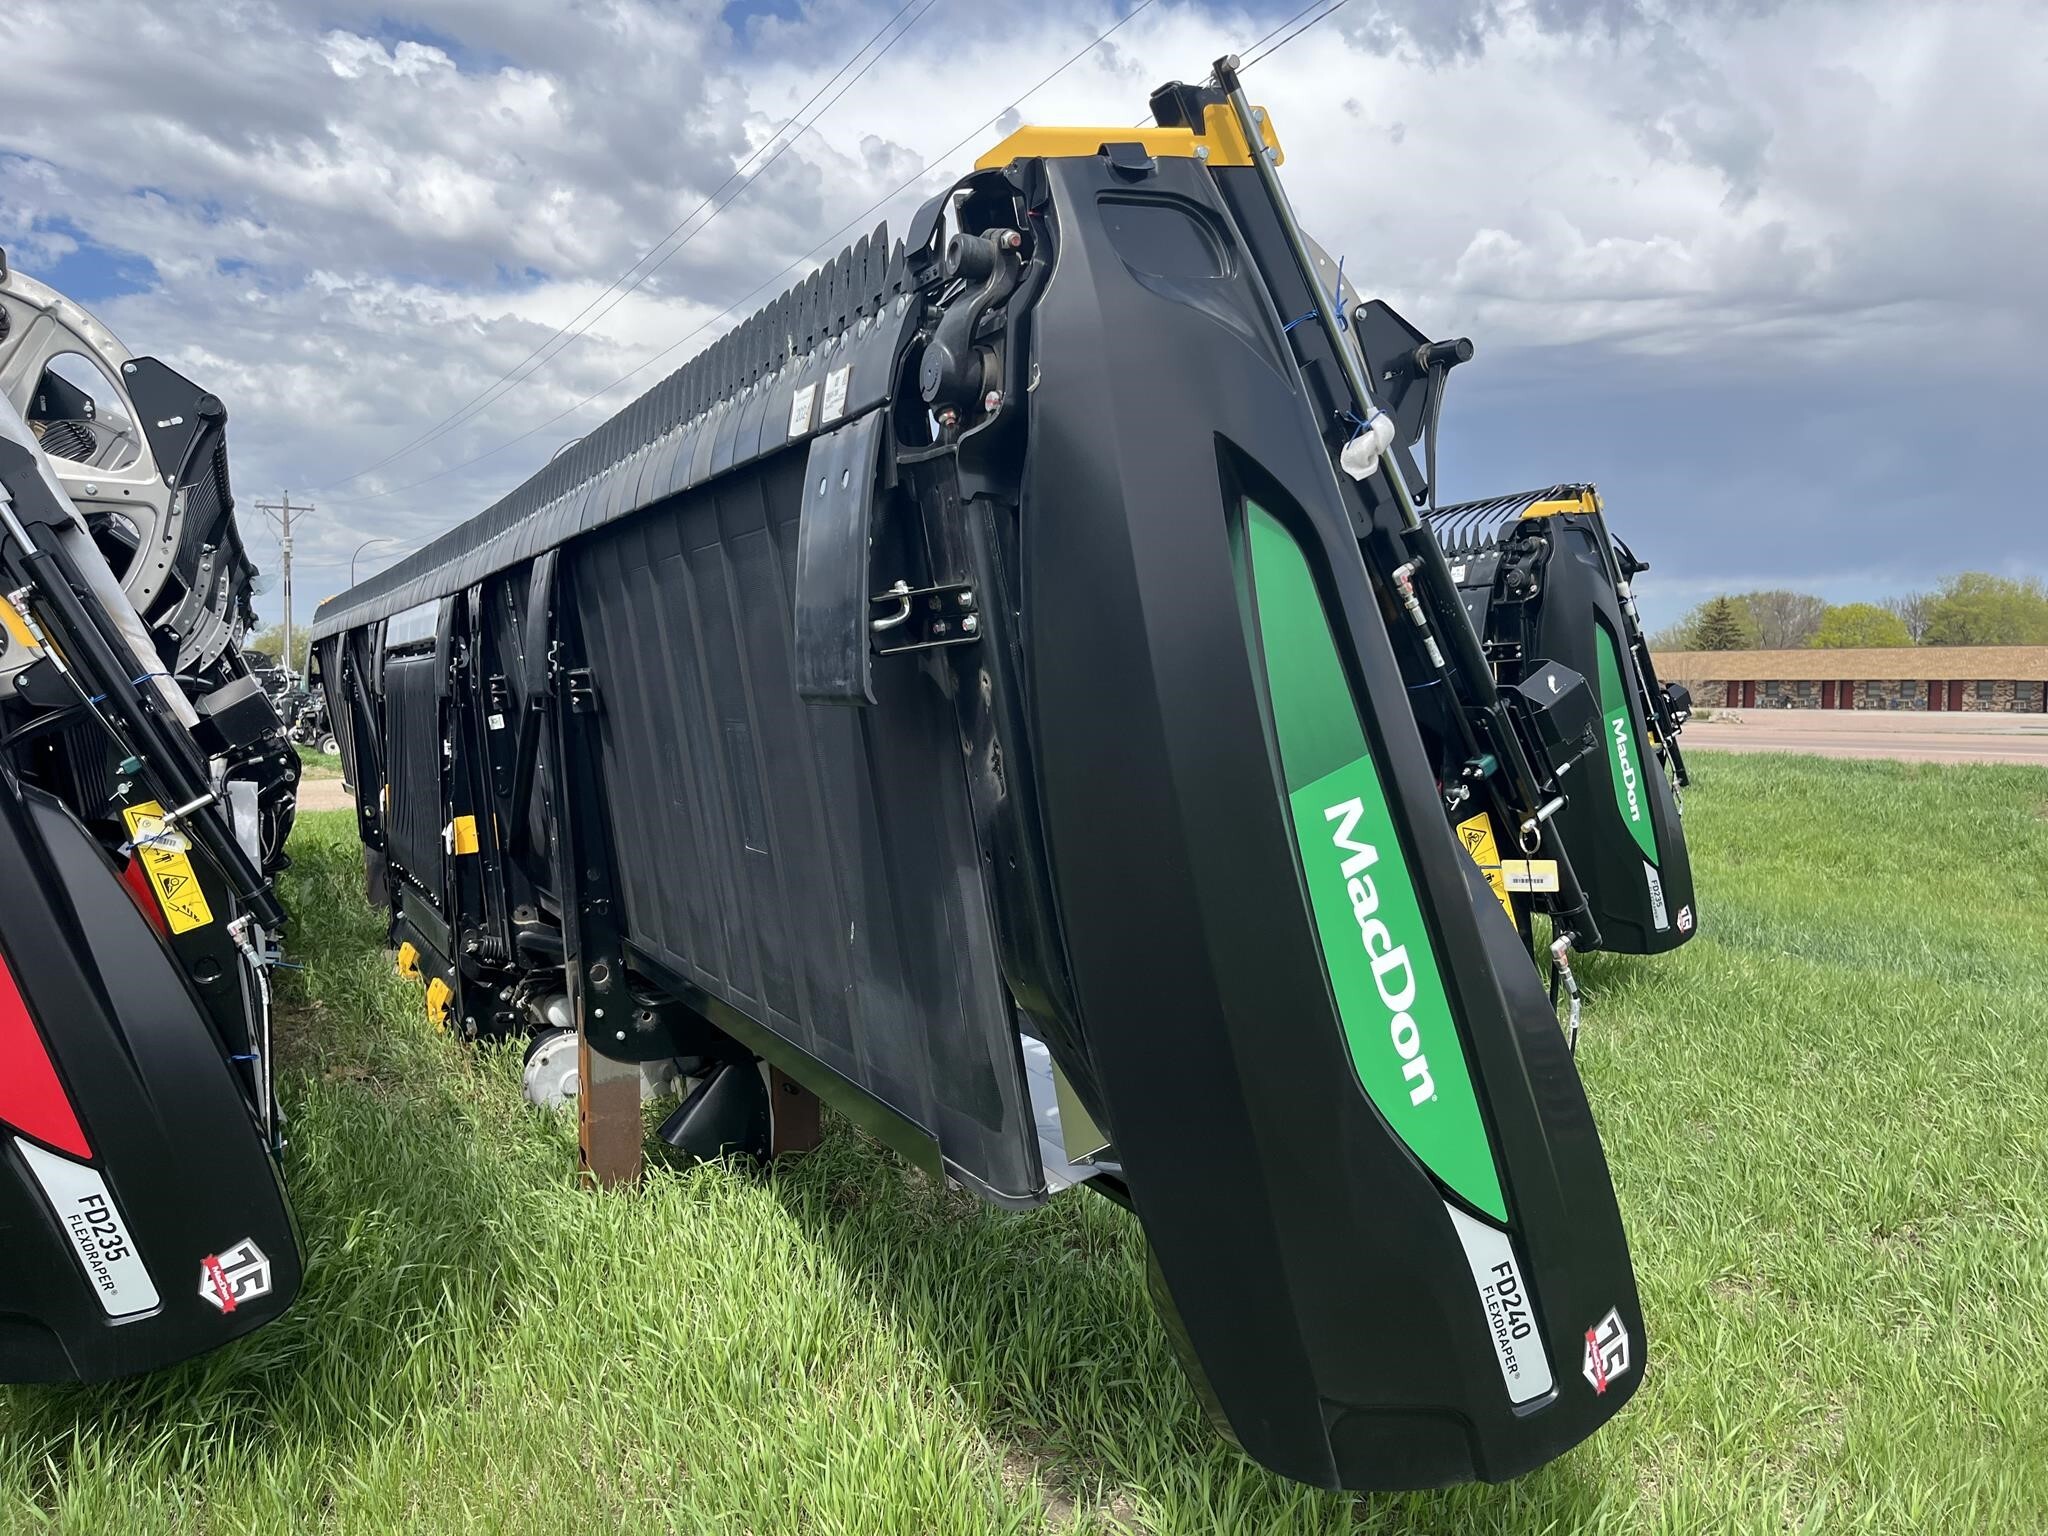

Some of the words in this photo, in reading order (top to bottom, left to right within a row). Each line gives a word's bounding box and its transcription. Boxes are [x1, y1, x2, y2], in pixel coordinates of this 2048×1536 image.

[1612, 718, 1640, 822] MacDon
[1651, 880, 1663, 908] FD235
[78, 1194, 130, 1262] FD235
[208, 1246, 264, 1302] 75
[1491, 1261, 1531, 1341] FD240
[1589, 1317, 1625, 1380] 75
